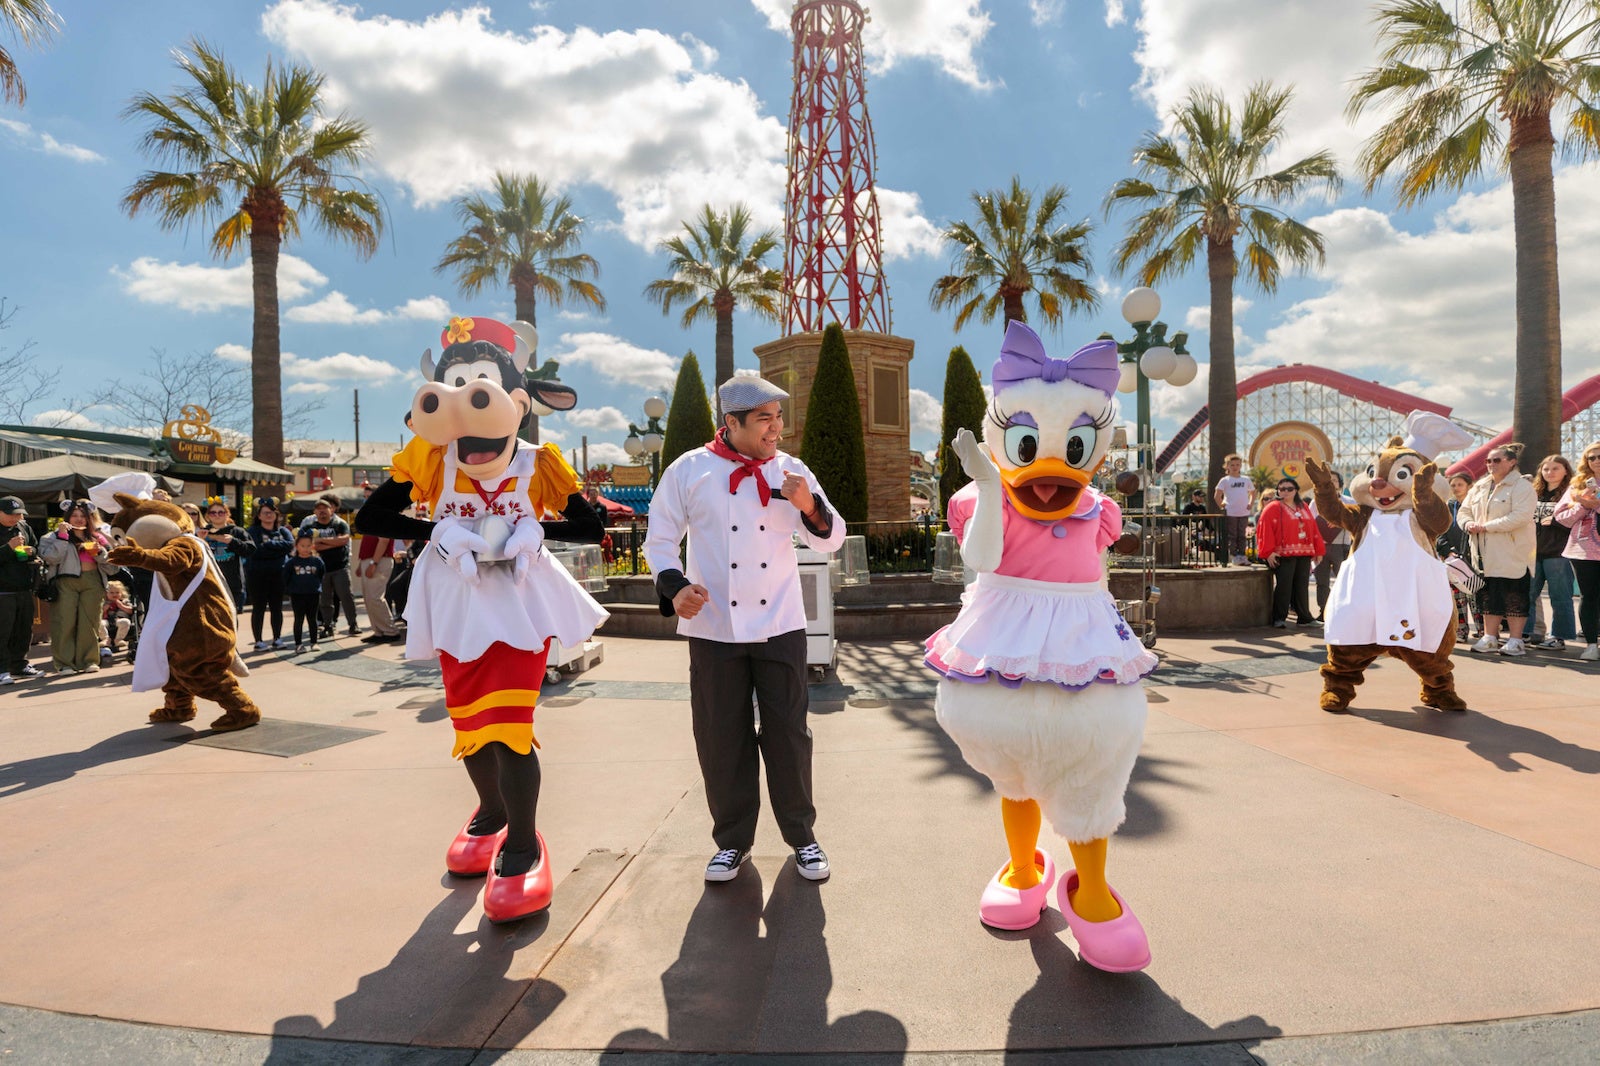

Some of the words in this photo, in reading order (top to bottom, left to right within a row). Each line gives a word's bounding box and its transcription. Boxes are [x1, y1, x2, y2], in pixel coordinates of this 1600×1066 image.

[1271, 440, 1312, 456] PIXAR
[188, 451, 210, 462] COFFEE
[1275, 450, 1306, 466] PIER
